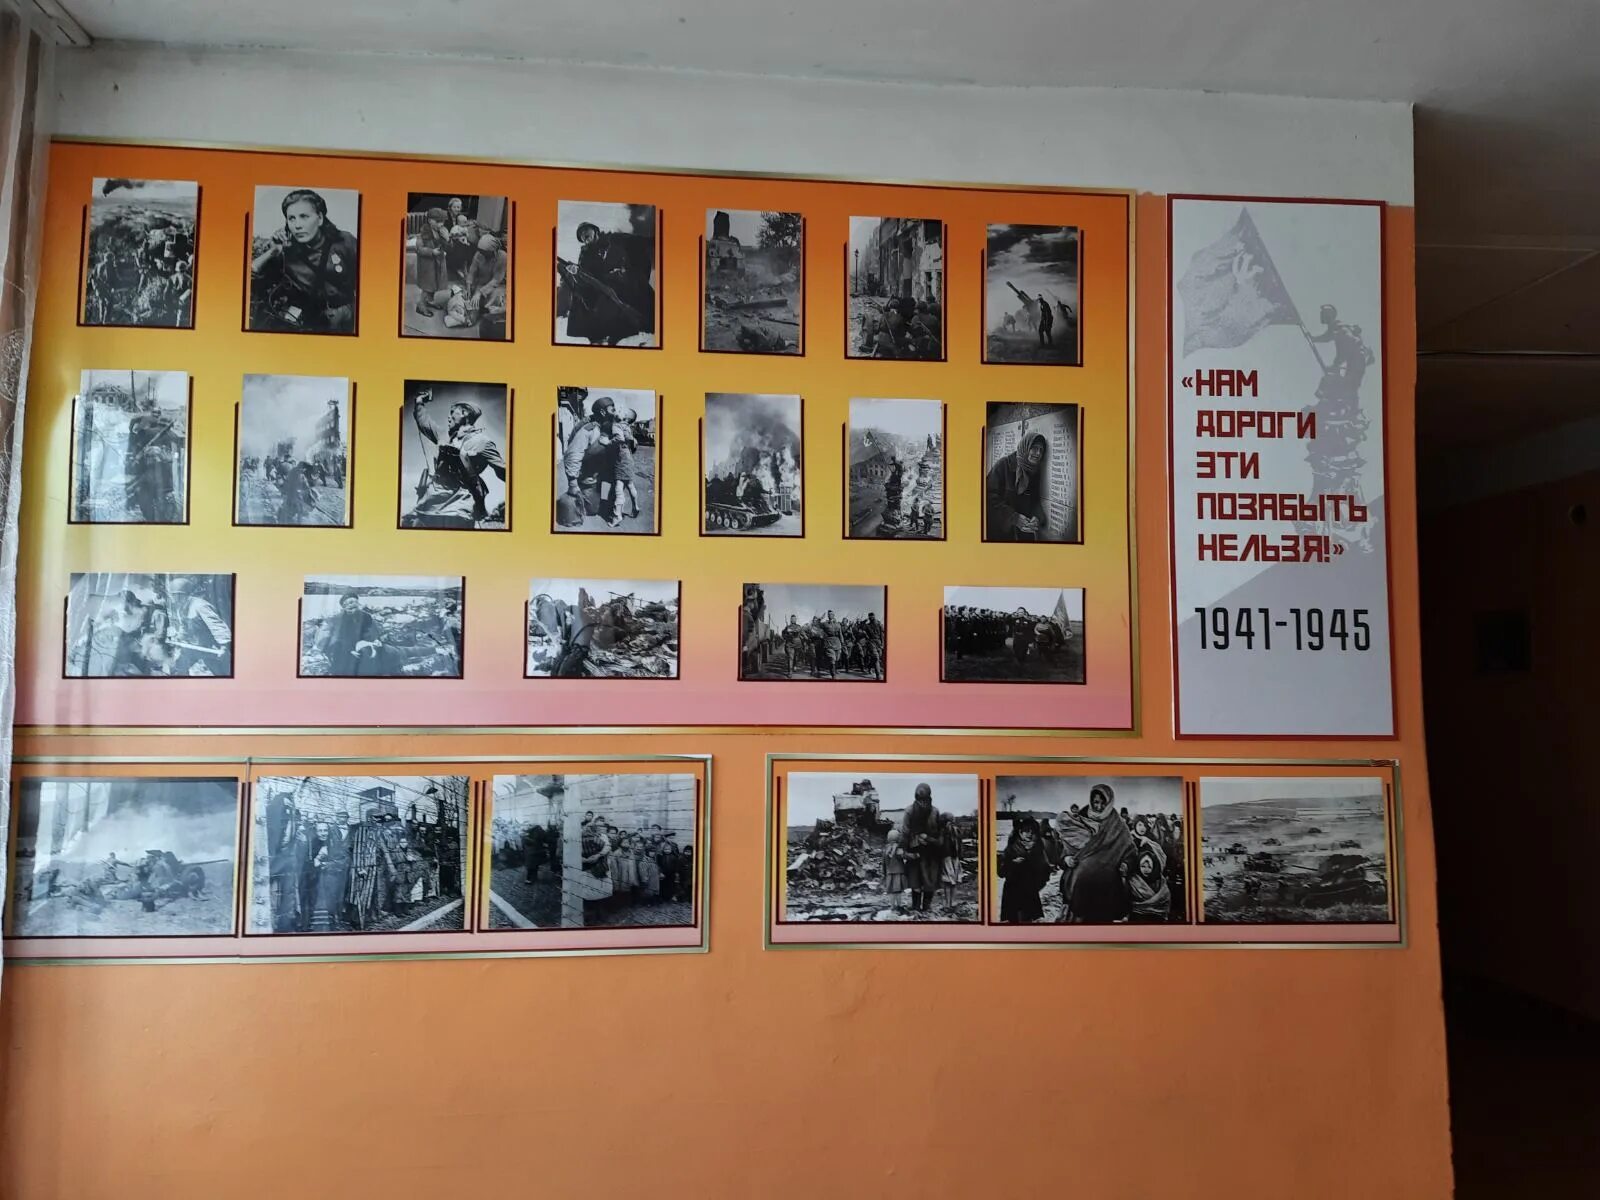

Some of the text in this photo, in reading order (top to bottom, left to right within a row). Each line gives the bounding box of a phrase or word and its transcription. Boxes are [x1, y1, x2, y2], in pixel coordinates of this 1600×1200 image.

[1181, 369, 1258, 397] «НАМ
[1196, 410, 1316, 439] ДОРОГИ
[1196, 451, 1260, 479] ЭТИ
[1197, 492, 1368, 522] ПОЗАБЫТЬ
[1198, 533, 1345, 562] НЕЛЬЗЯ!»
[1195, 607, 1371, 651] 1941-1945
